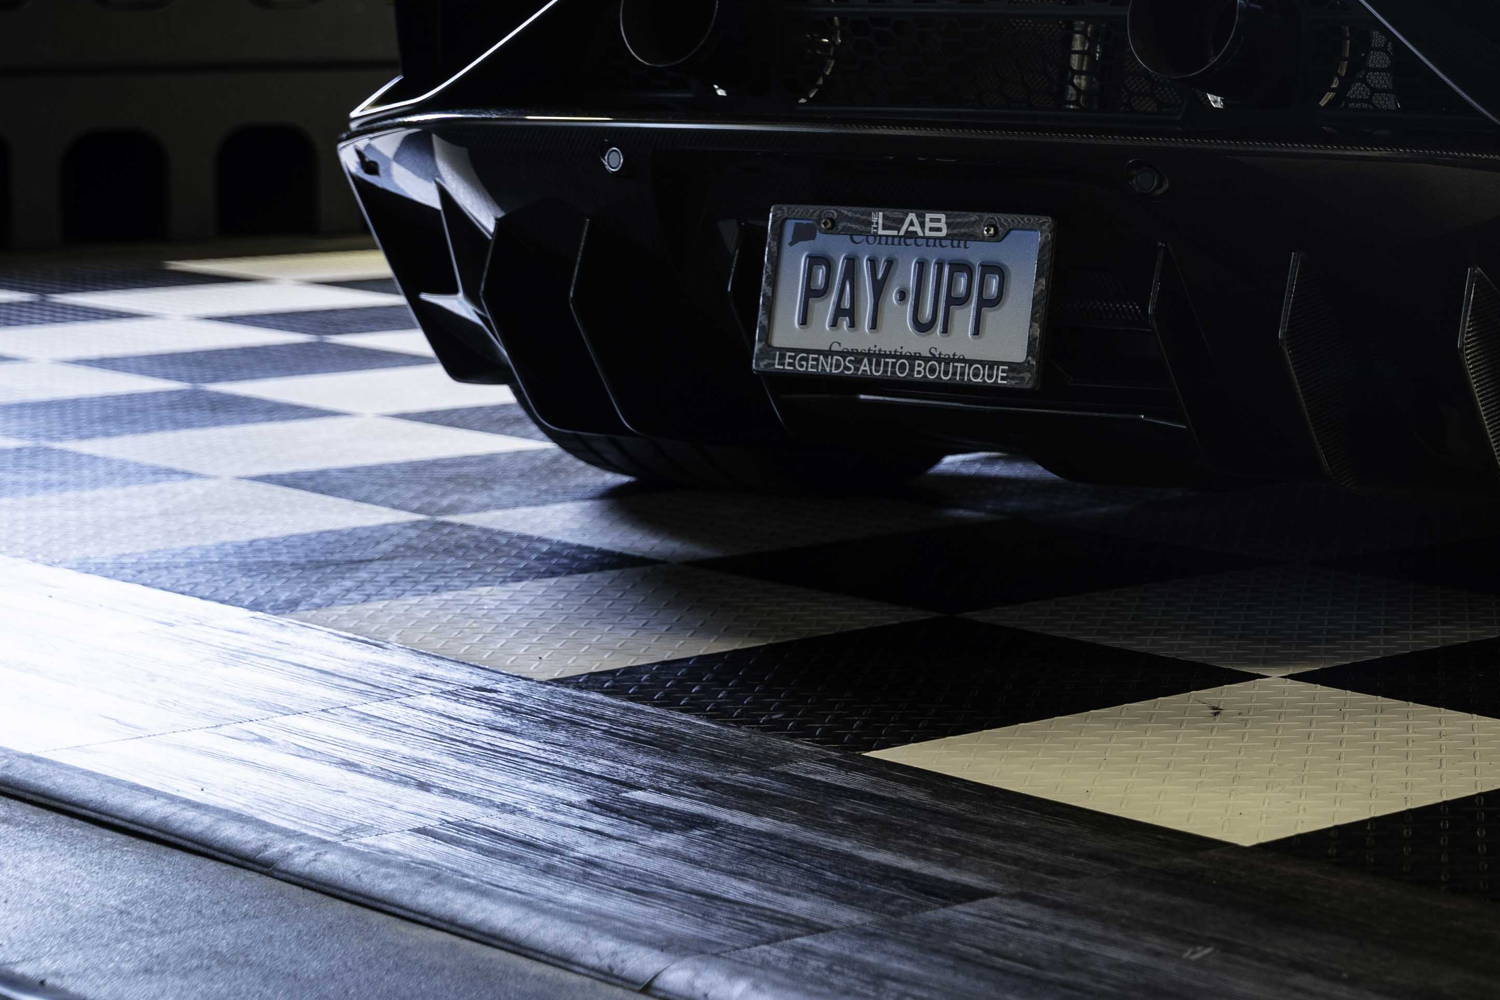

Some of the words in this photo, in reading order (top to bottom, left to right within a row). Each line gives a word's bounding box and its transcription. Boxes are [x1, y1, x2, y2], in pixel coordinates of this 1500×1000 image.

[877, 211, 948, 237] LAB
[774, 350, 855, 375] LEGENDS
[858, 357, 910, 378] AUTO
[913, 360, 1009, 385] BOUTIQUE
